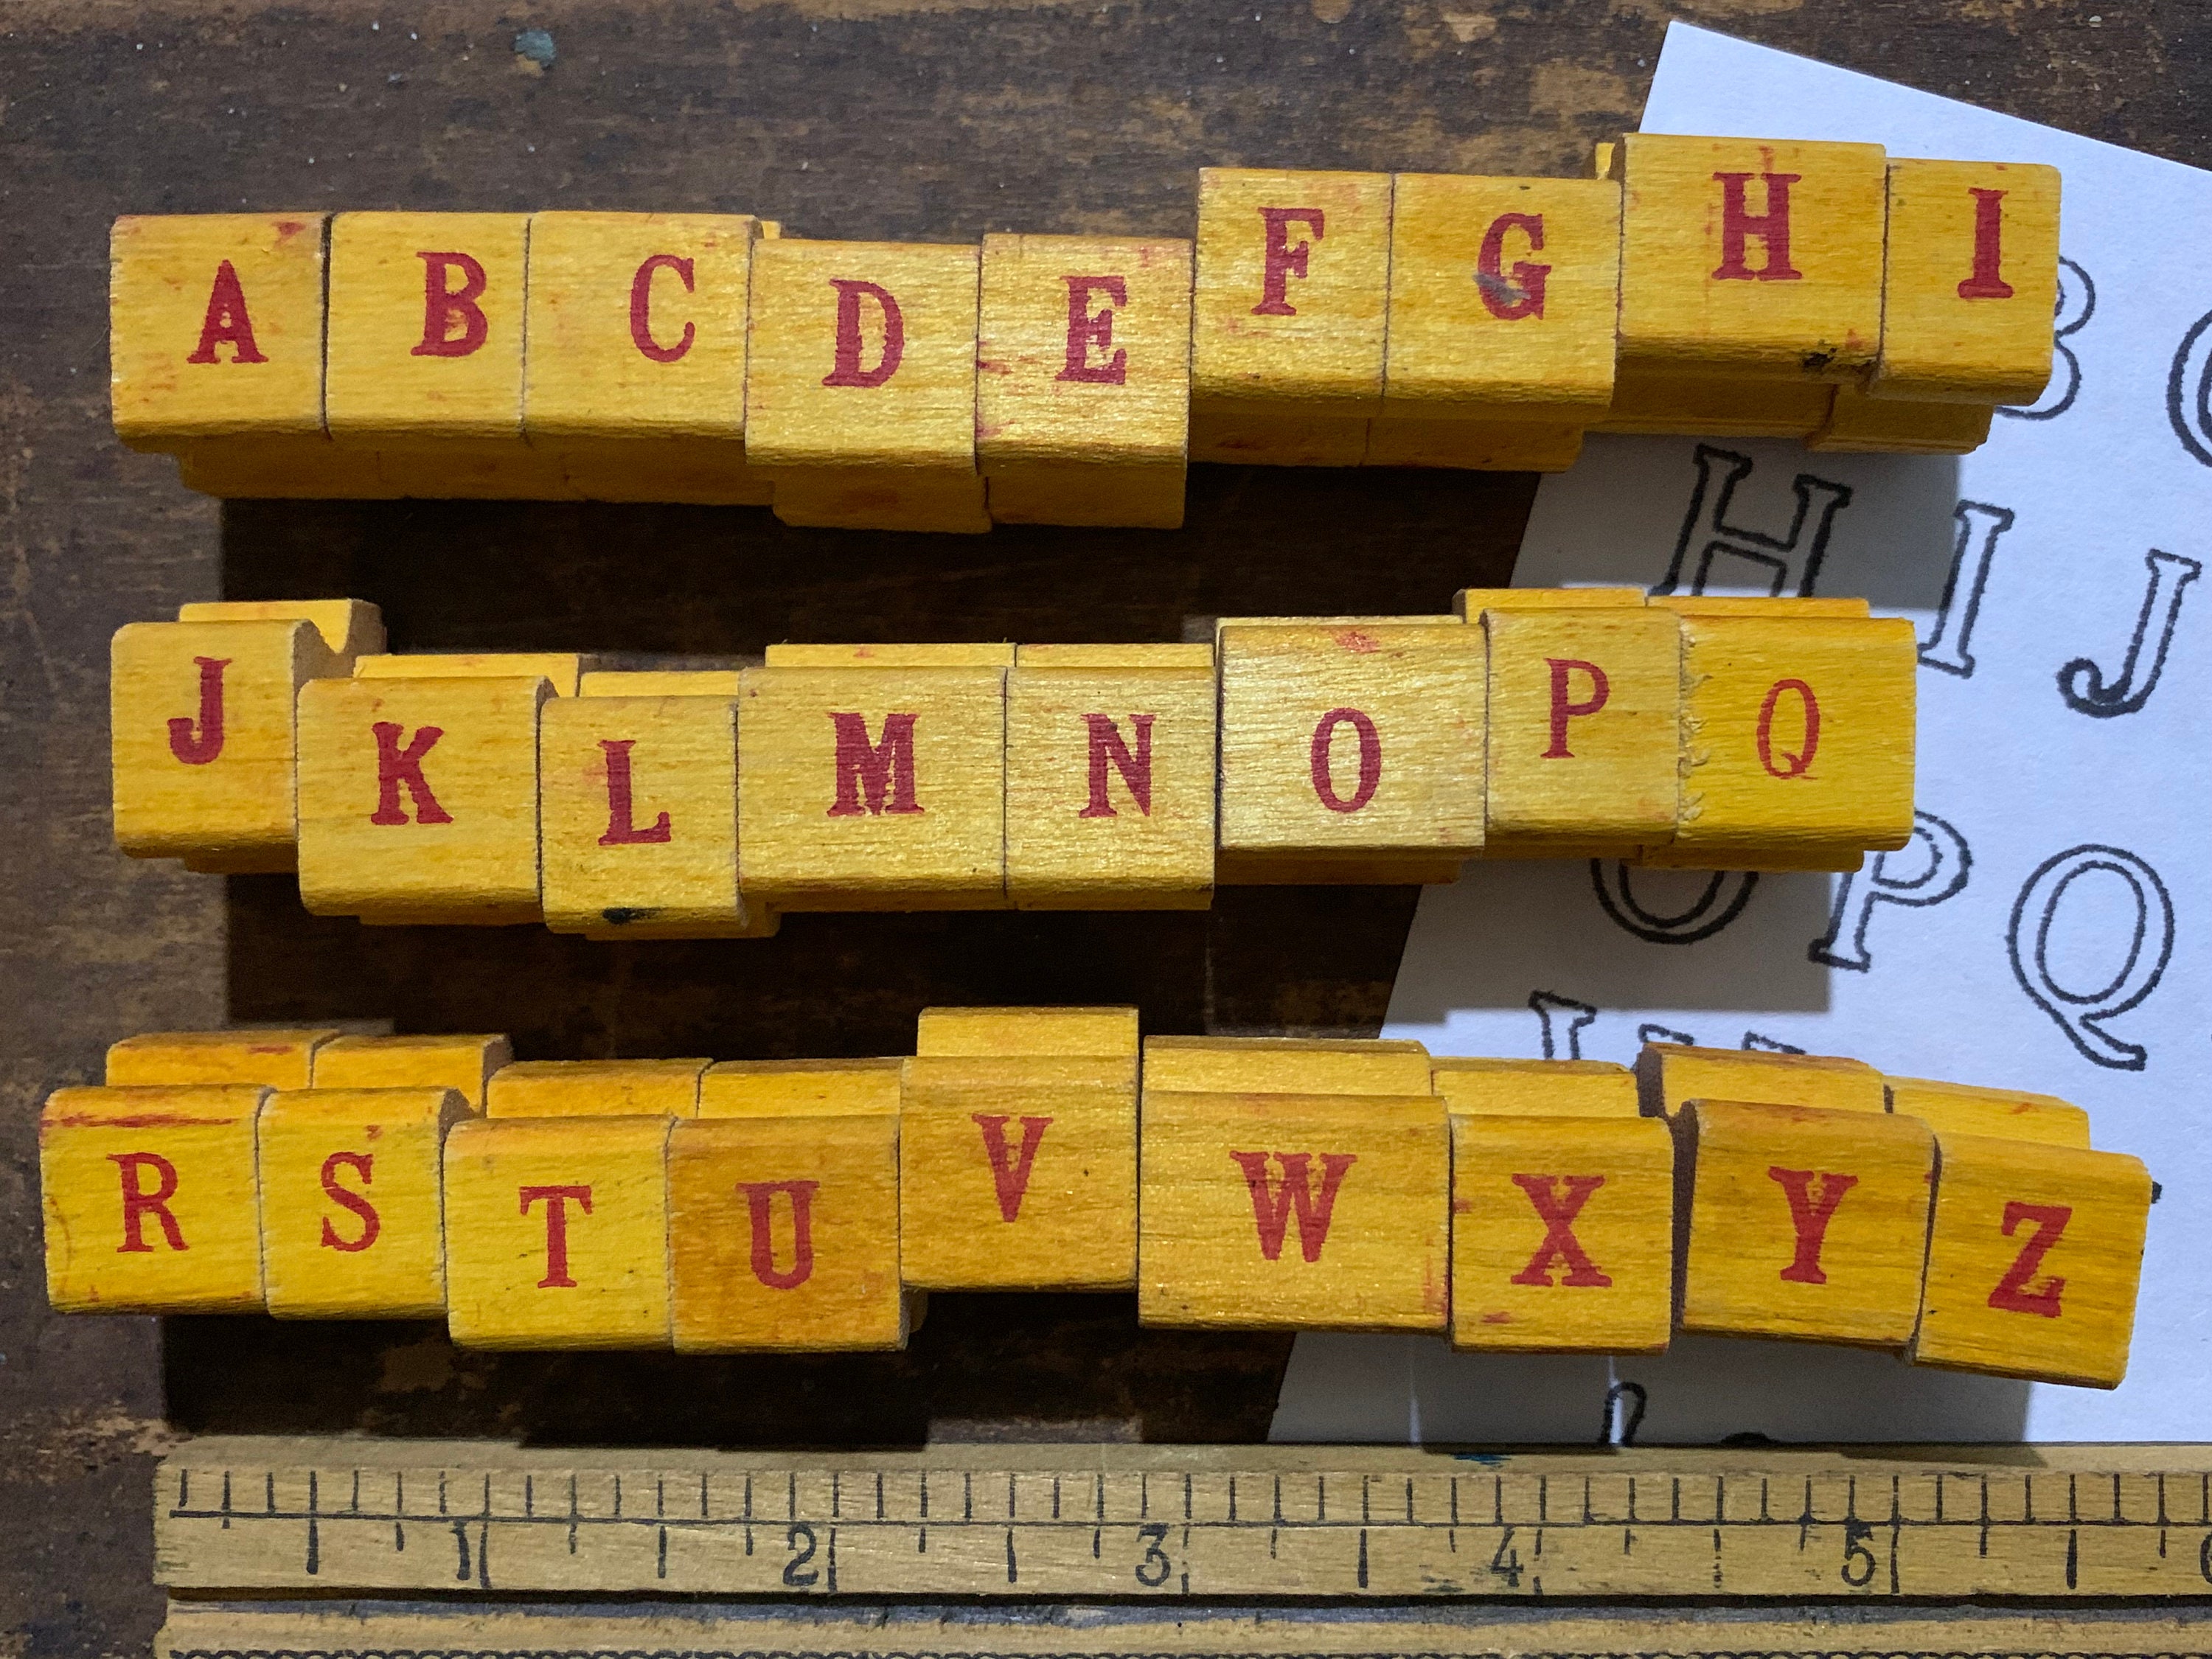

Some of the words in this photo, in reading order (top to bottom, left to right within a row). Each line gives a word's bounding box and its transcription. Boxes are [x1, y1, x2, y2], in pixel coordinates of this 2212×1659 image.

[188, 261, 268, 363] A
[412, 252, 488, 356] B
[630, 255, 695, 362] C
[824, 279, 905, 388] D
[1057, 276, 1127, 383] E
[1251, 208, 1324, 315] F
[1477, 213, 1551, 320] G
[1712, 172, 1802, 280] H
[1958, 187, 2014, 299] I
[1644, 444, 1853, 598] H
[1917, 499, 2014, 679] I
[2056, 549, 2201, 718] J
[169, 656, 232, 765] J
[372, 722, 453, 825] K
[599, 740, 671, 844] L
[827, 712, 924, 817] M
[1079, 714, 1155, 818] N
[1311, 708, 1381, 813] O
[1540, 658, 1610, 759] P
[1756, 678, 1820, 781] Q
[1809, 811, 1972, 971] P
[2006, 844, 2175, 1071] Q
[107, 1153, 187, 1253] R
[321, 1152, 378, 1251] S
[520, 1186, 593, 1288] T
[737, 1180, 820, 1290] U
[971, 1113, 1055, 1222] V
[1228, 1150, 1357, 1262] W
[1510, 1175, 1611, 1287] X
[1769, 1167, 1858, 1283] Y
[1987, 1201, 2072, 1318] Z
[449, 1525, 470, 1581] 1
[782, 1522, 819, 1587] 2
[1135, 1523, 1171, 1587] 3
[1489, 1525, 1524, 1587] 4
[1840, 1520, 1876, 1587] 5
